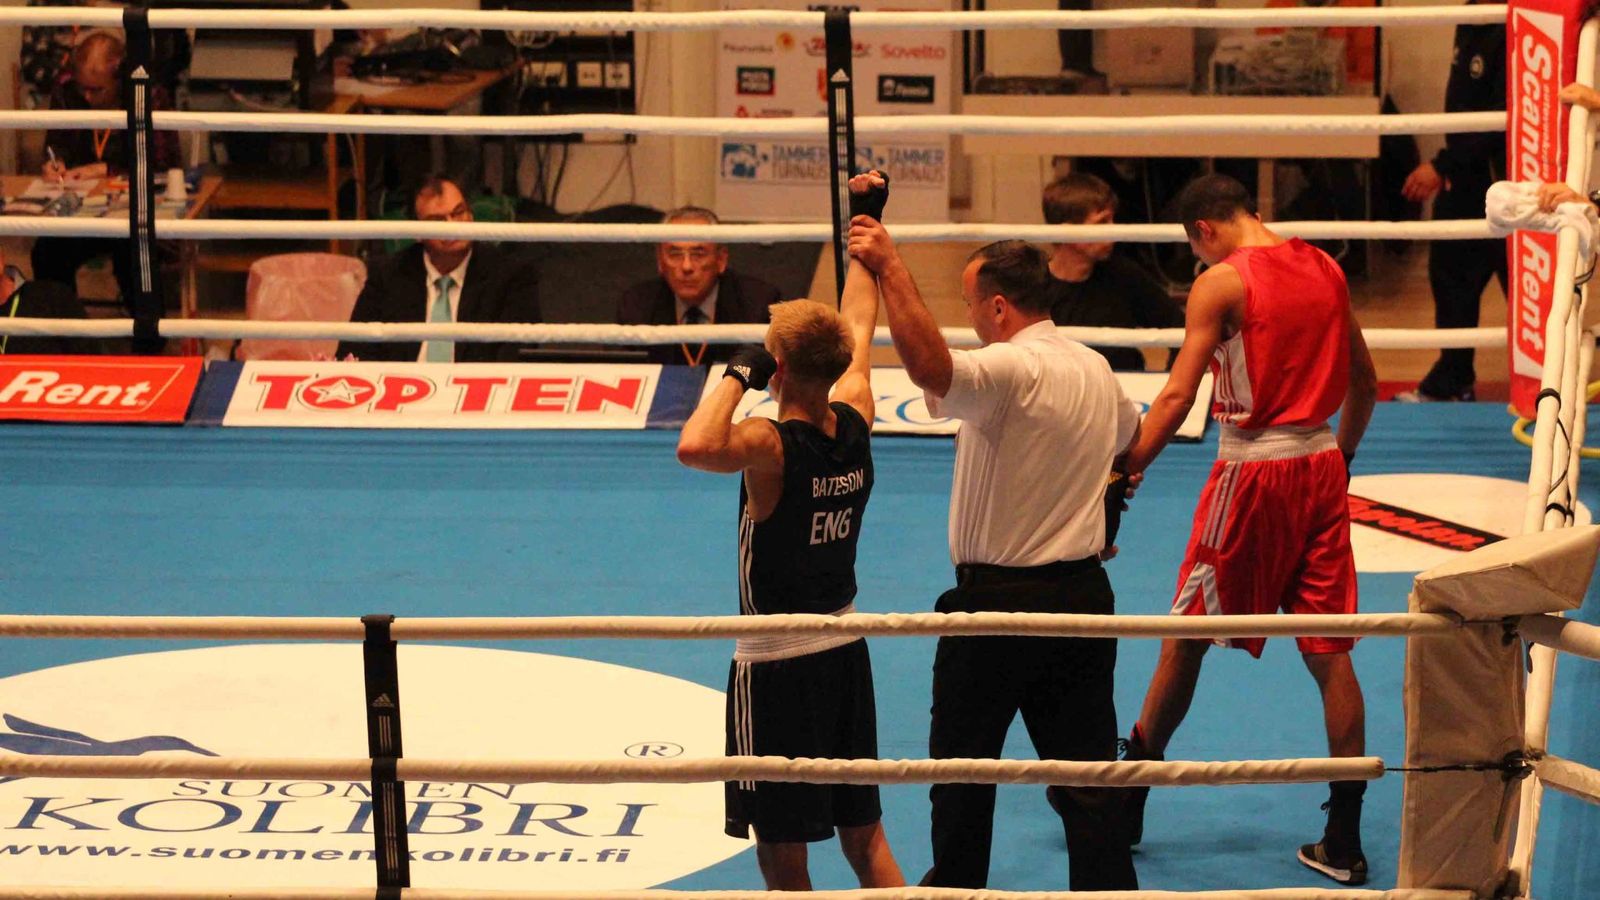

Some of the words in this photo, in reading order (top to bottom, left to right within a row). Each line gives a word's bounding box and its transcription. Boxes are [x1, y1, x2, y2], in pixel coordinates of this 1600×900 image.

[1522, 34, 1551, 183] Scand
[1522, 233, 1551, 351] Rent
[0, 370, 152, 407] Rent
[253, 374, 435, 412] TOP
[451, 376, 645, 413] TEN
[812, 468, 864, 498] BATESON
[809, 507, 853, 545] ENG
[4, 796, 659, 838] KOLIBRI
[0, 844, 632, 864] www.suomenolibri.fi
